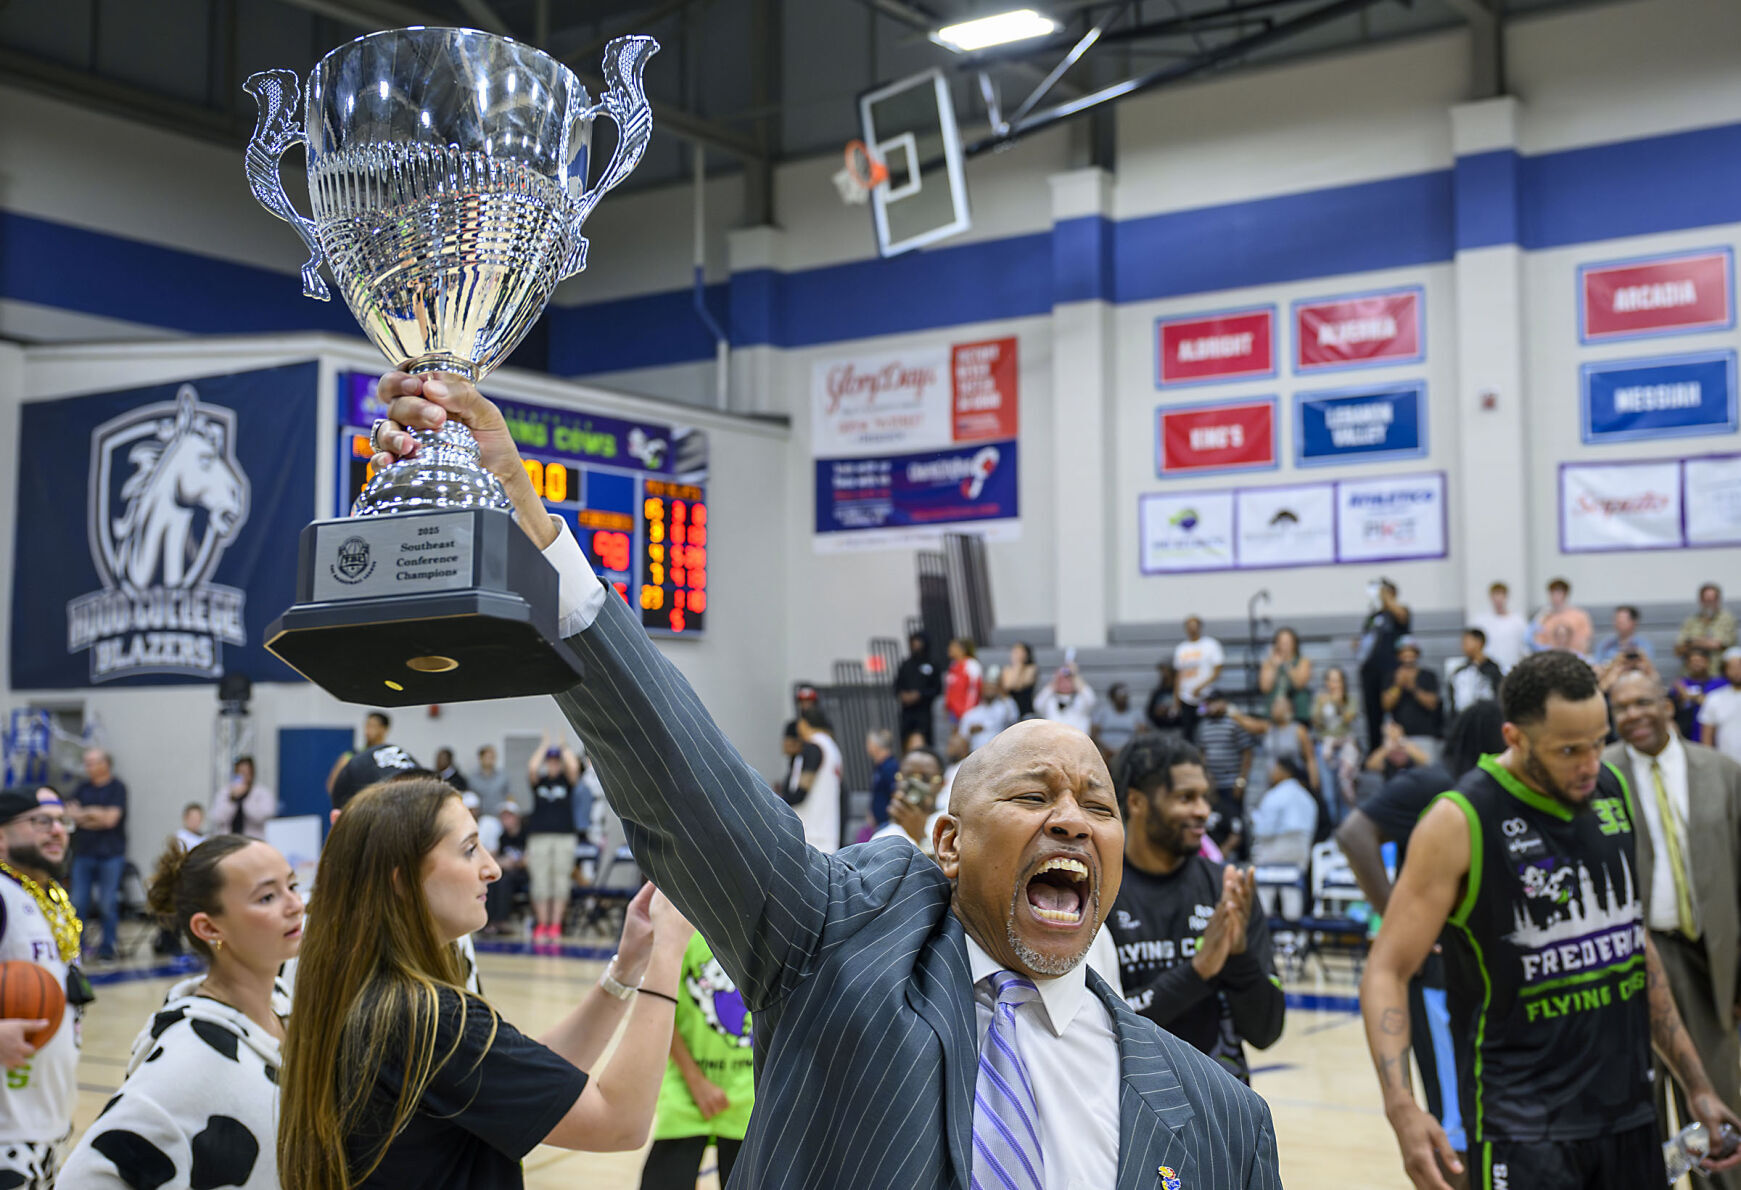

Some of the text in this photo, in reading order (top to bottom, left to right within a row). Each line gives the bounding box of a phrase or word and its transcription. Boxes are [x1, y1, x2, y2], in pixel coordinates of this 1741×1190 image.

[1613, 280, 1698, 313] ARCADIA
[417, 526, 440, 536] 2025
[400, 540, 455, 552] Southeast
[396, 554, 458, 567] Conference
[396, 568, 458, 582] Champions
[96, 632, 214, 671] BLAZERS
[1117, 940, 1175, 966] LYING
